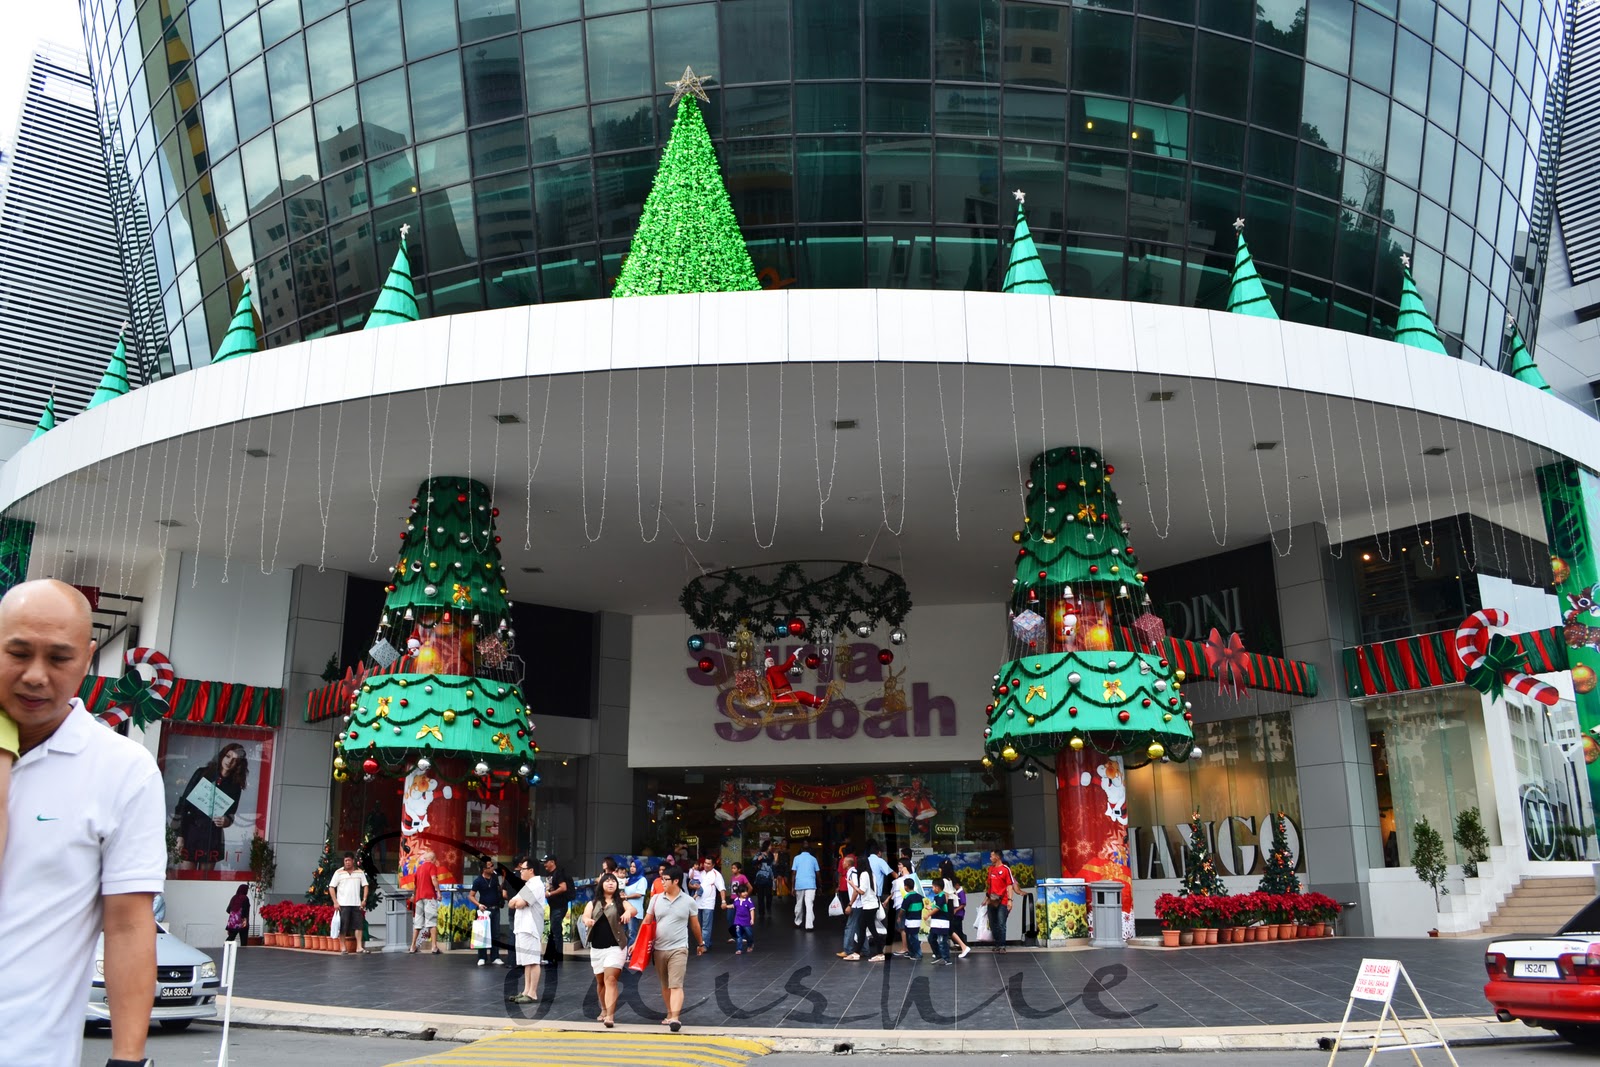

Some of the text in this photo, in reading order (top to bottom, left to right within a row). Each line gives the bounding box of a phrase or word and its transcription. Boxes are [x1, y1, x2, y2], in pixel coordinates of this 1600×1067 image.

[1164, 587, 1244, 642] DINI
[714, 682, 957, 742] Sabah
[781, 782, 868, 799] Merry Christmas
[180, 847, 243, 862] SPRIT
